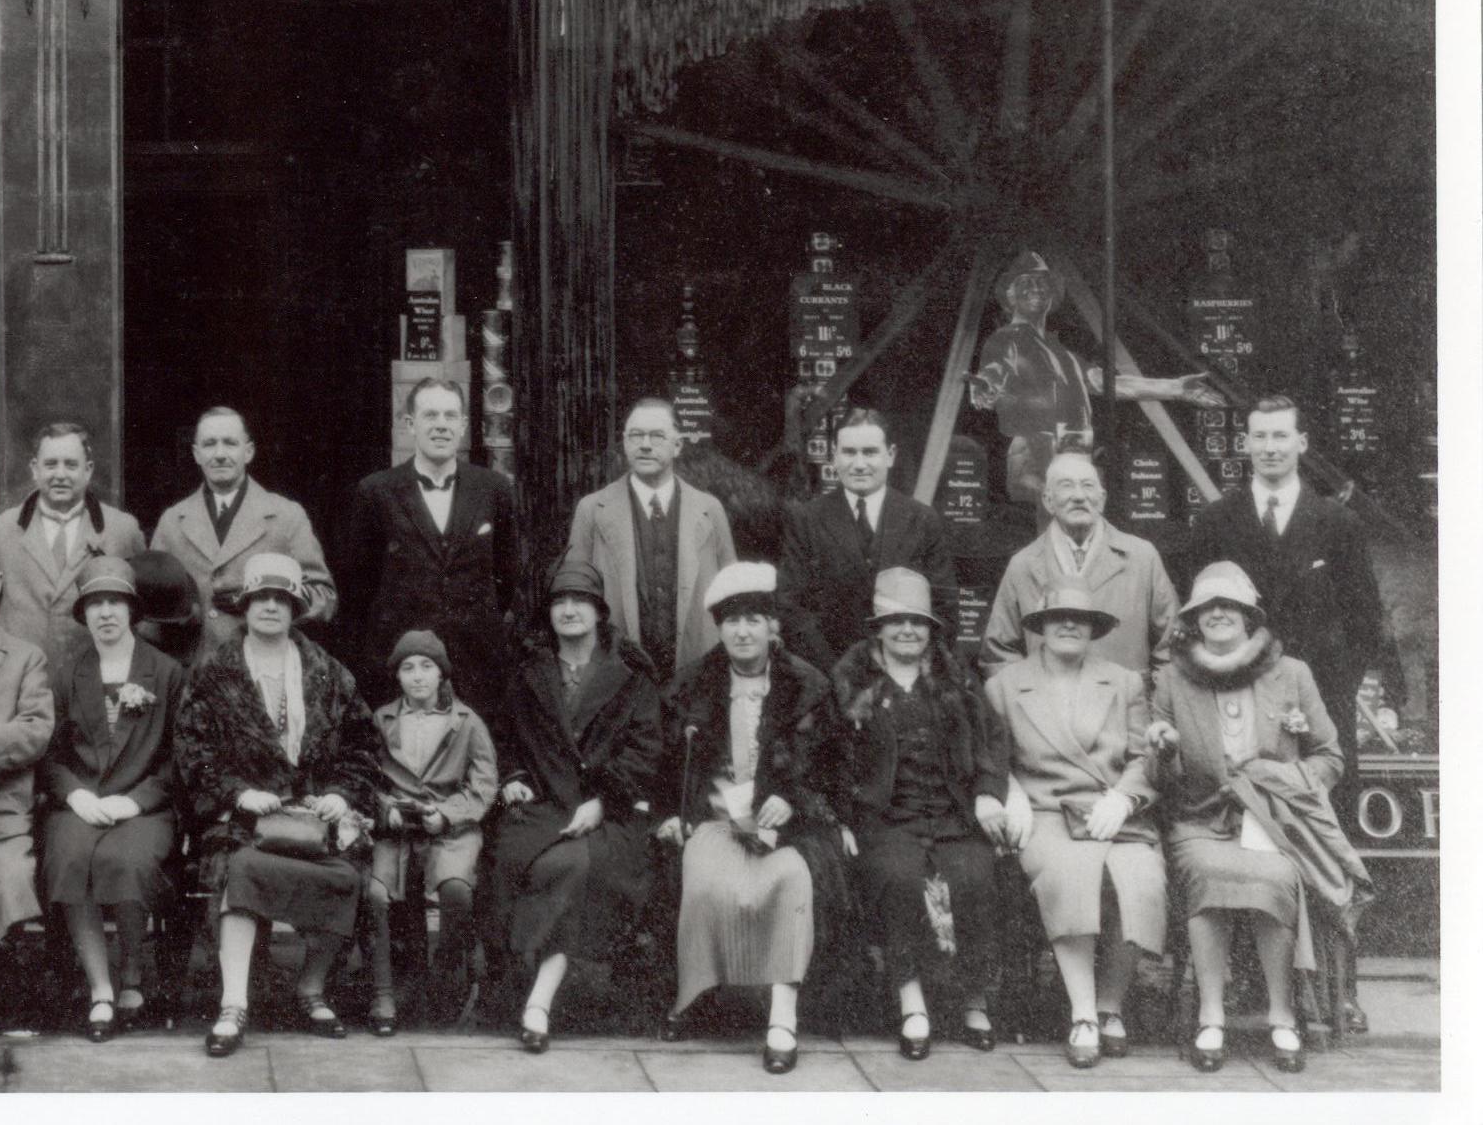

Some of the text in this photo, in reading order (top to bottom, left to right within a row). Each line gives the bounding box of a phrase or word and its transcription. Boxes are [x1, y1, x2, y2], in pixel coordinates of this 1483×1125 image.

[822, 283, 853, 291] BLACK
[799, 296, 849, 304] CURRANTS
[799, 345, 807, 357] 6
